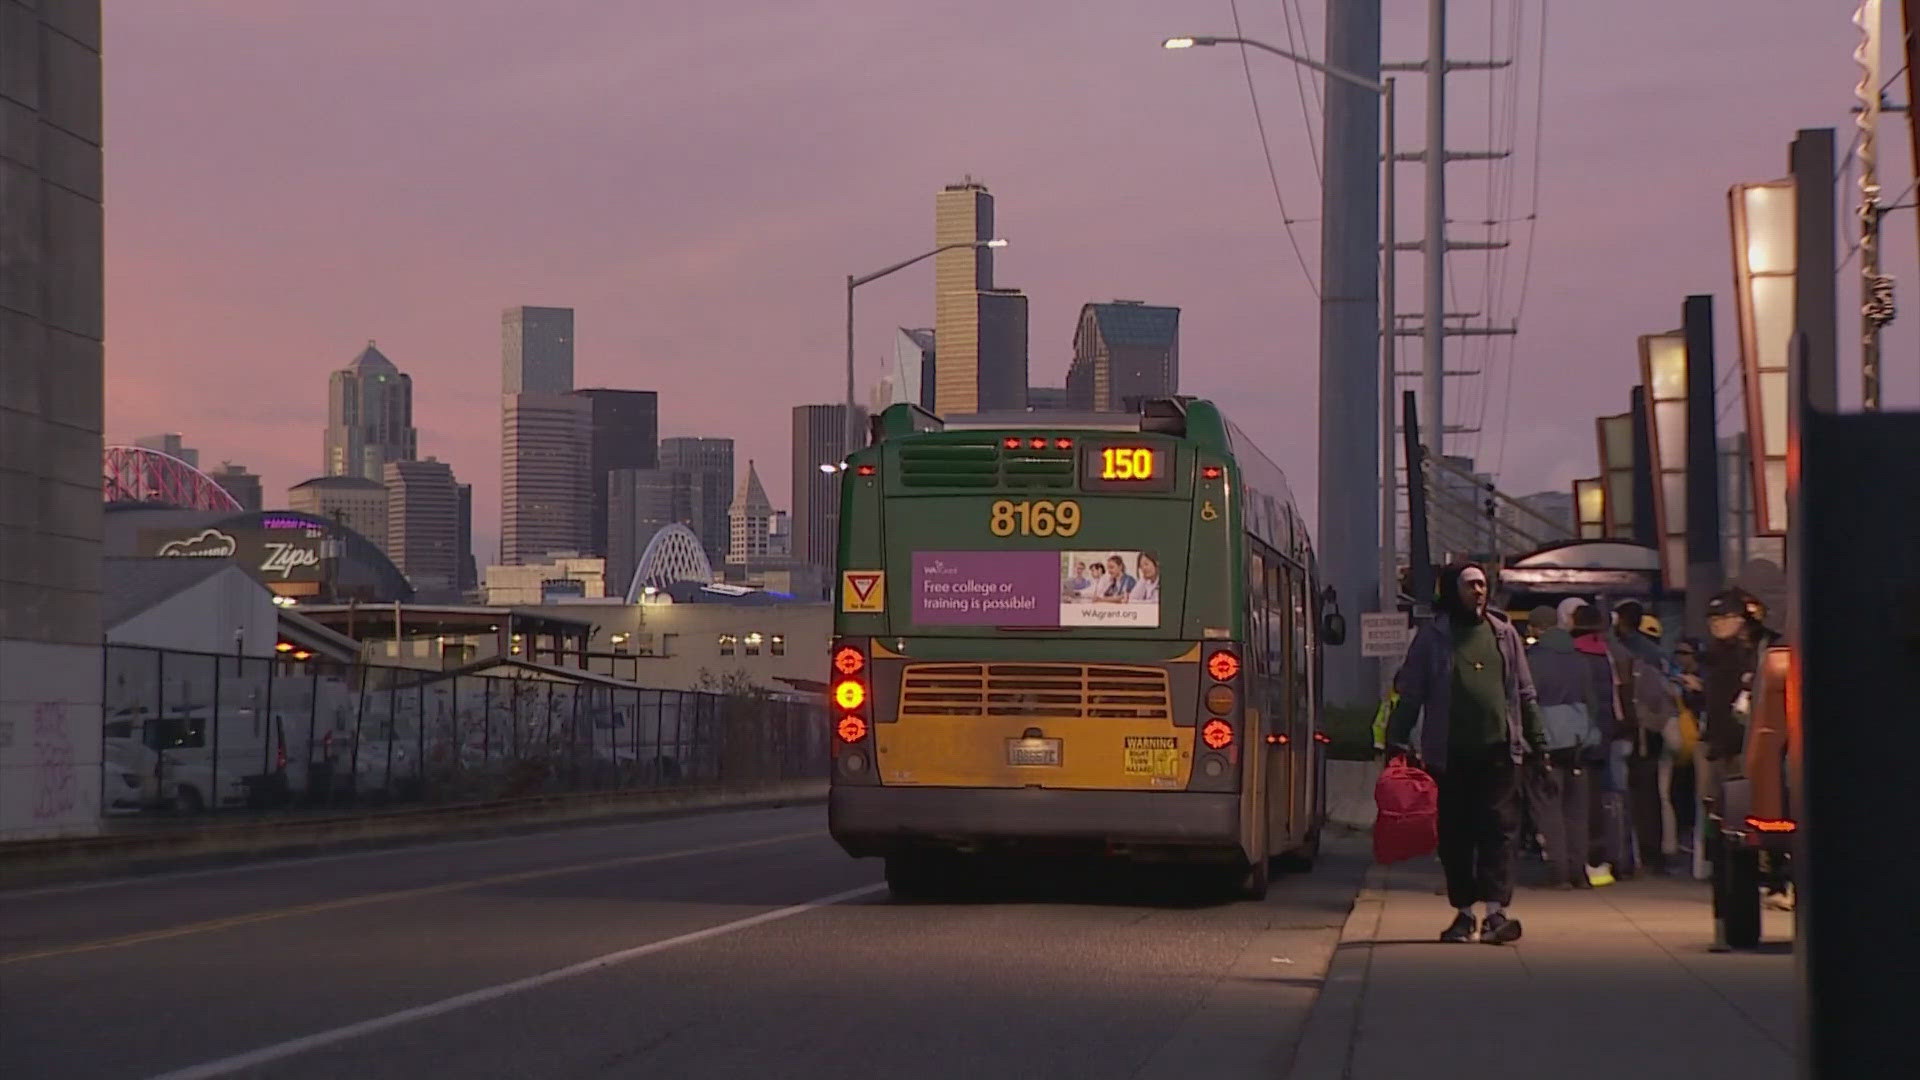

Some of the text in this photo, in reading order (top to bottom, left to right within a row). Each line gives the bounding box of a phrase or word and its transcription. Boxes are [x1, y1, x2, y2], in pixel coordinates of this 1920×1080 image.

[1102, 447, 1153, 480] 150
[989, 499, 1082, 538] 8169
[260, 543, 319, 579] Zips
[923, 579, 1013, 597] Free college or
[923, 597, 1036, 612] training is possible!
[1081, 609, 1138, 620] WAgrant.org
[1127, 738, 1175, 749] WARNING
